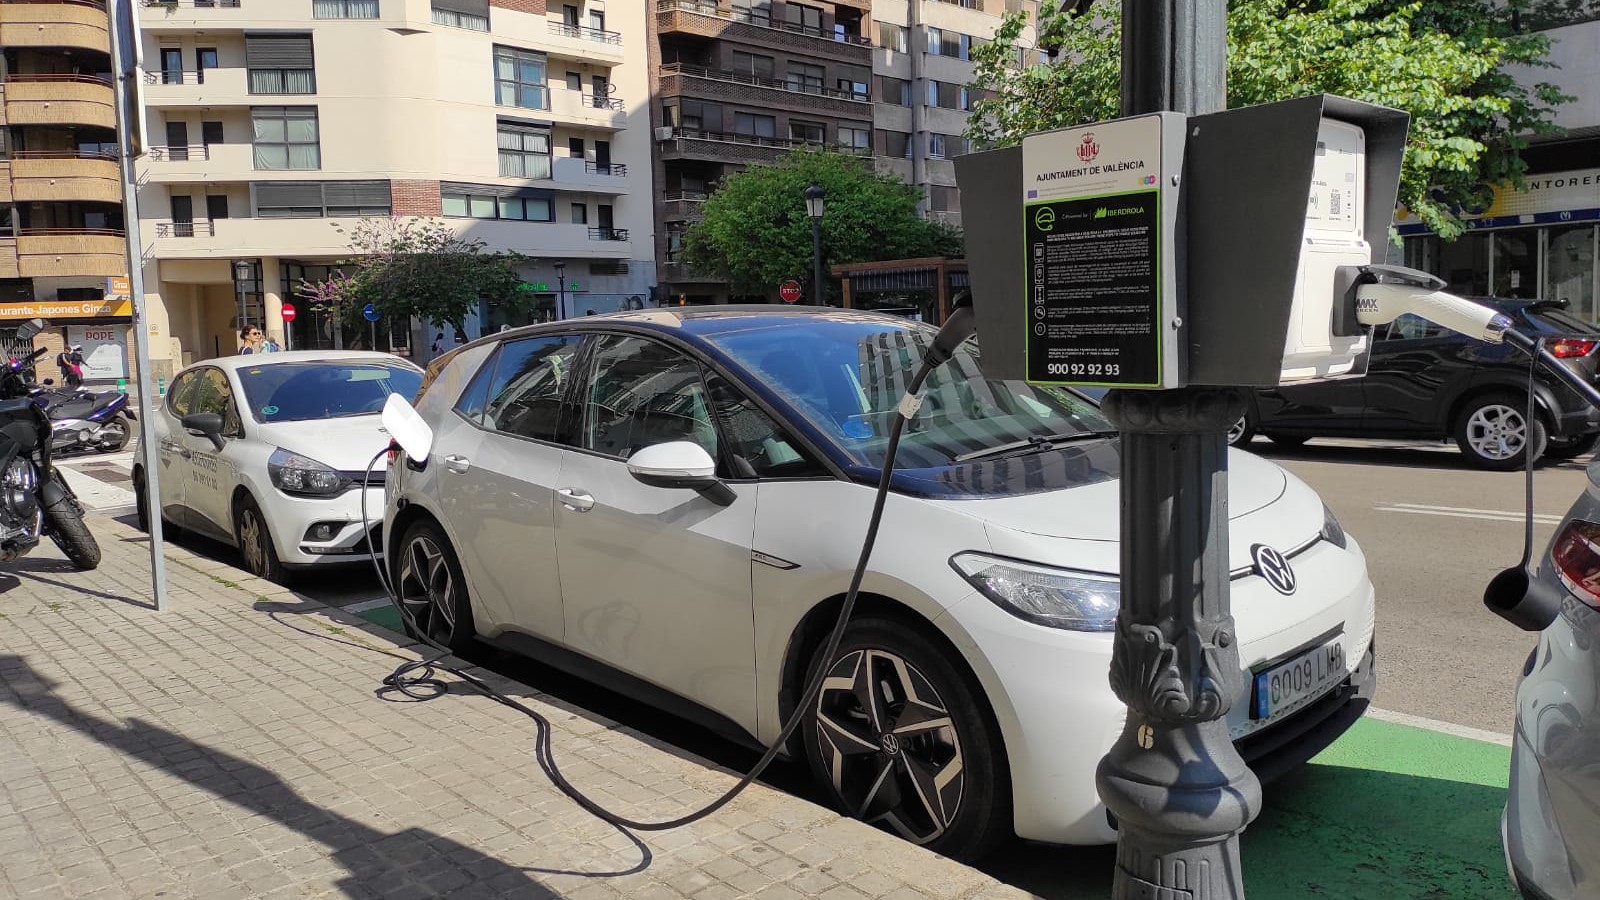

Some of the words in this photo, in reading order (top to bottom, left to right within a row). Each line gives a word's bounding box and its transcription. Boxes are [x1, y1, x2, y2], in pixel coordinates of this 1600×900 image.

[1036, 167, 1088, 182] AJUNTAMENT
[1089, 166, 1100, 175] DE
[1102, 160, 1144, 173] VALÈNCIA
[1514, 174, 1600, 191] NTORE
[1107, 206, 1145, 217] IBERDROLA
[0, 306, 33, 316] urante
[37, 304, 80, 317] Japones
[82, 303, 112, 314] Ginza
[85, 331, 115, 341] POPE
[1047, 363, 1069, 375] 900
[1070, 363, 1085, 375] 92
[1087, 363, 1102, 375] 92
[1105, 364, 1120, 376] 93
[1271, 658, 1312, 705] 0009
